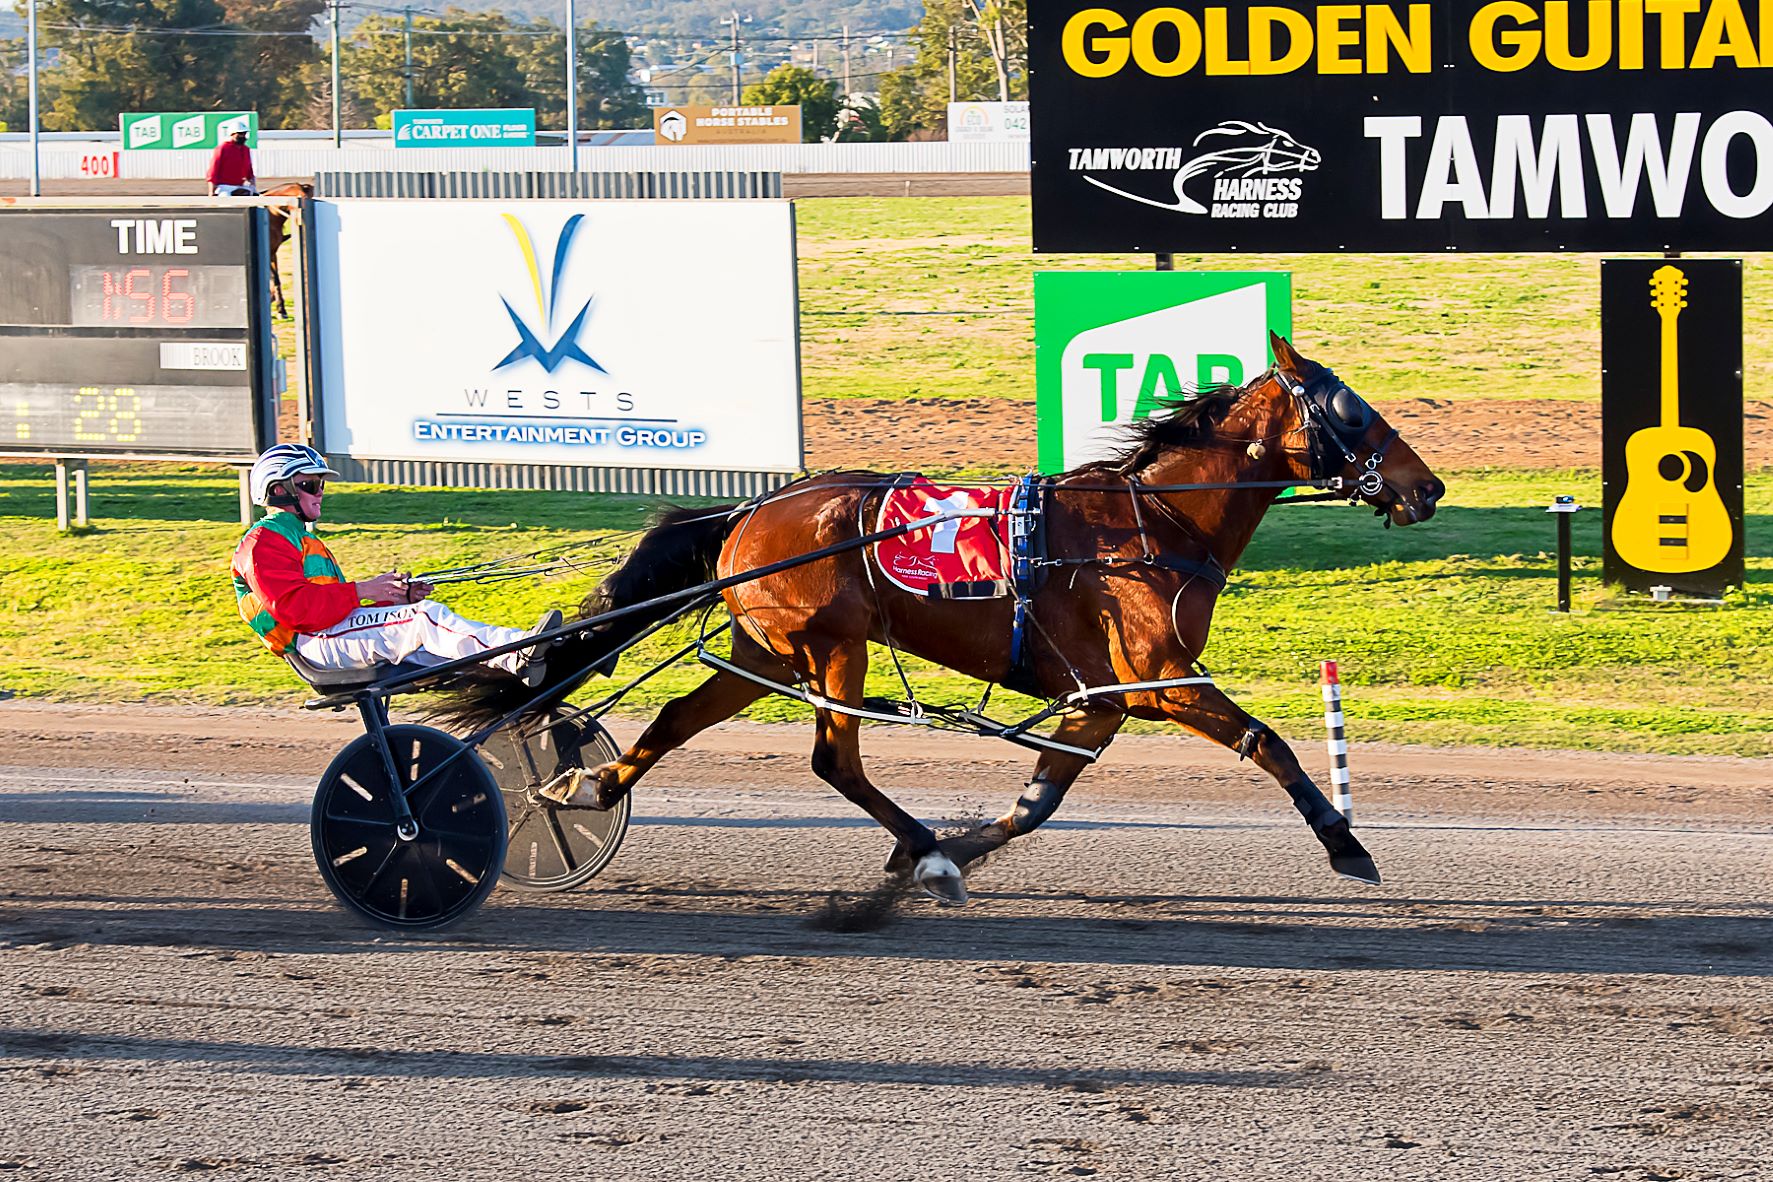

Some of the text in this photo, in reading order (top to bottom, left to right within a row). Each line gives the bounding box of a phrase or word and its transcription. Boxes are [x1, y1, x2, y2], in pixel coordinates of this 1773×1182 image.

[1061, 0, 1773, 79] GOLDEN GUITA
[711, 107, 773, 117] PORTABLE
[1003, 105, 1030, 114] SOLA
[695, 116, 789, 127] HORSE STABLES
[1004, 118, 1028, 130] 042
[134, 126, 157, 138] TAB
[177, 126, 201, 138] TAB
[412, 124, 469, 139] CARPET
[469, 124, 502, 139] ONE
[81, 155, 109, 176] 400
[1068, 147, 1182, 170] TAMWORTH
[1363, 110, 1773, 219] TAMWO
[1212, 178, 1303, 201] HARNESS
[1211, 203, 1299, 218] RACING CLUB
[110, 219, 199, 255] TIME
[193, 347, 241, 366] BROOK
[464, 388, 635, 412] WESTS
[413, 420, 706, 449] ENTERTAINMENT GROUP
[893, 565, 917, 576] Harness
[917, 569, 938, 580] Racing
[348, 605, 420, 628] TOM ISON
